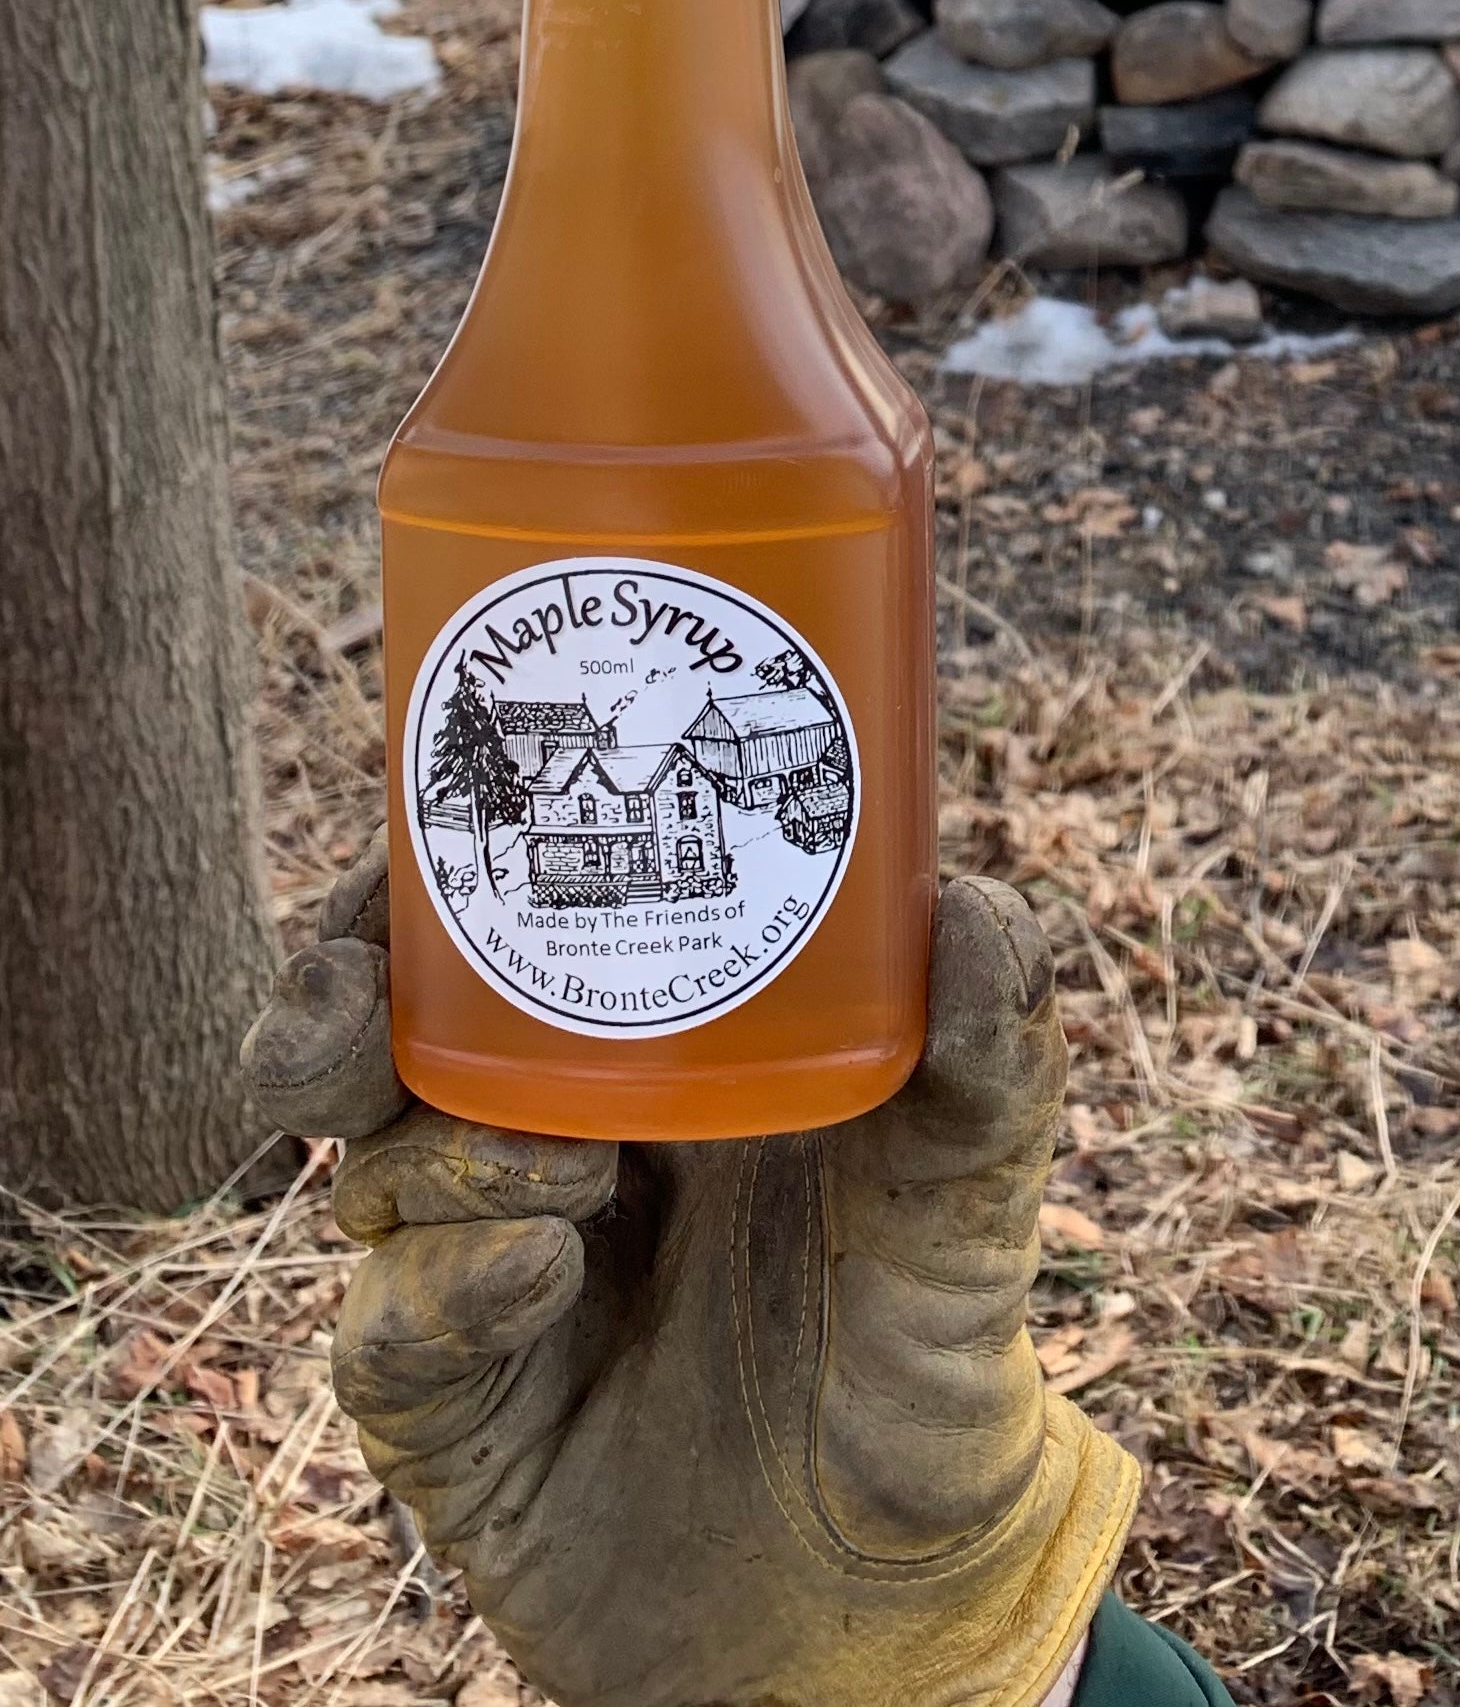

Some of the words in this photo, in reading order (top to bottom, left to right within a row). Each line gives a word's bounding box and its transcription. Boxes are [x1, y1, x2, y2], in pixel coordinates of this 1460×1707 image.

[469, 575, 604, 685] Maple
[611, 580, 744, 675] Syrup
[580, 657, 635, 675] 500ml
[518, 912, 569, 930] Made
[576, 912, 598, 933] by
[601, 911, 638, 929] The
[645, 907, 720, 927] Friends
[724, 901, 746, 919] of
[485, 894, 810, 1012] www.BronteCreek.org
[546, 939, 611, 957] Bronte
[615, 937, 674, 954] Creek
[679, 933, 722, 952] Park
